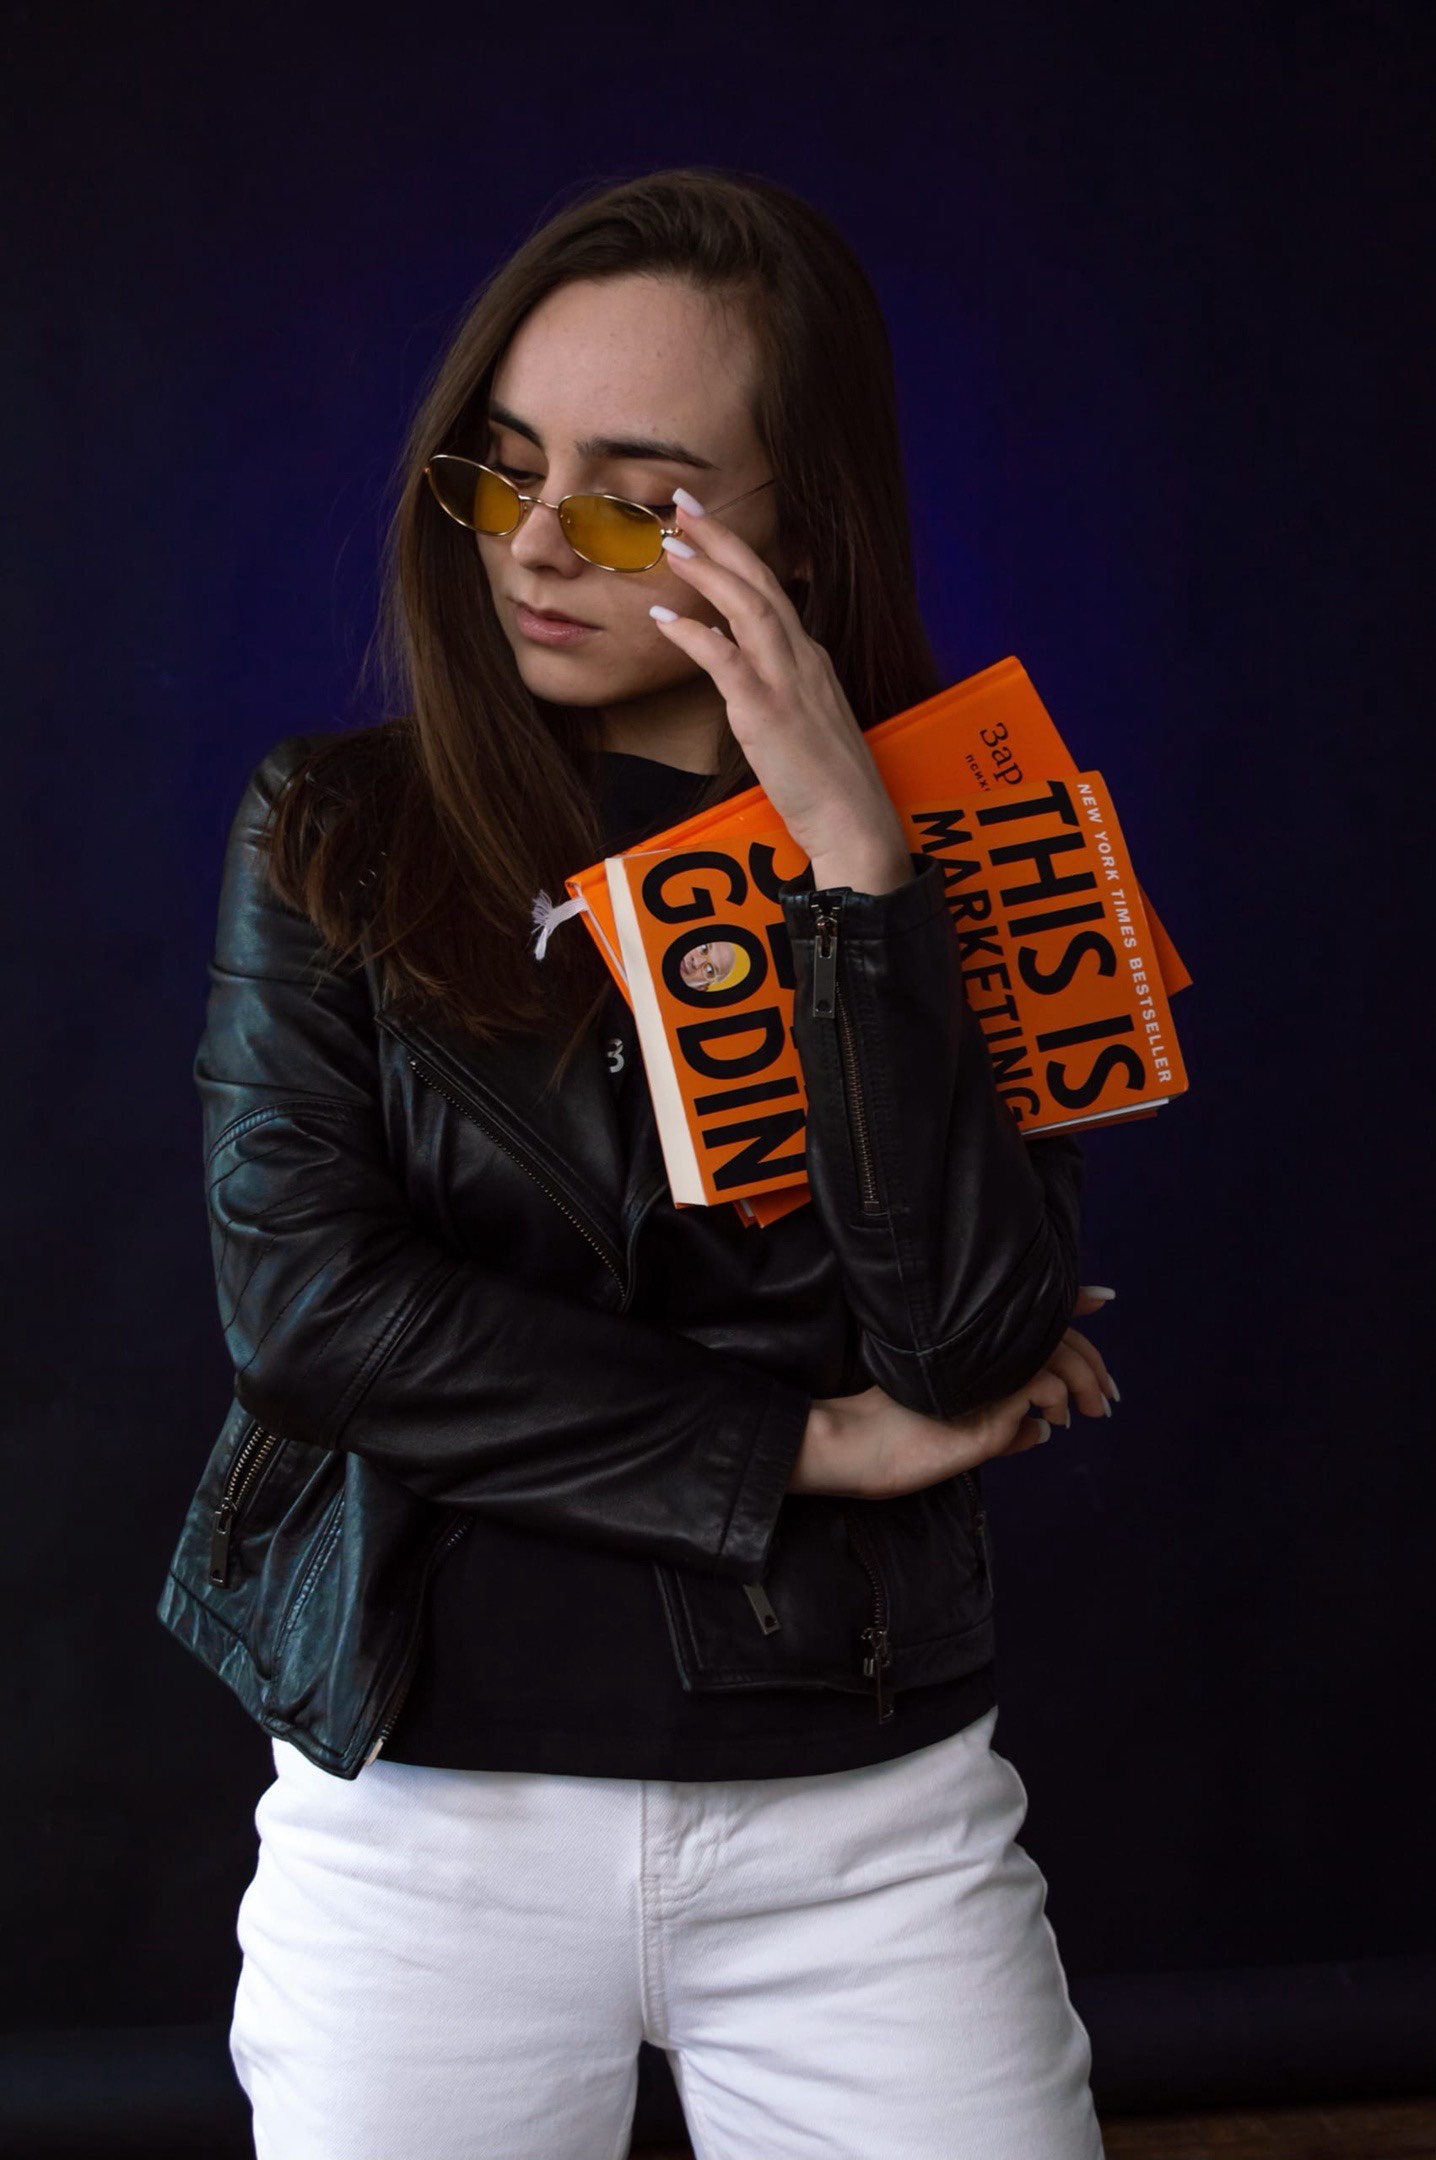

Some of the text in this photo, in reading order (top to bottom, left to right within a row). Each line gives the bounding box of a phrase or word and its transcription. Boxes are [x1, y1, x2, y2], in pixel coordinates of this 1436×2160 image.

[641, 850, 807, 1192] GODIN
[911, 809, 1041, 1123] MARKETING
[976, 780, 1146, 1110] THIS IS
[1077, 783, 1172, 1083] NEW YORK TIMES BESTSELLER
